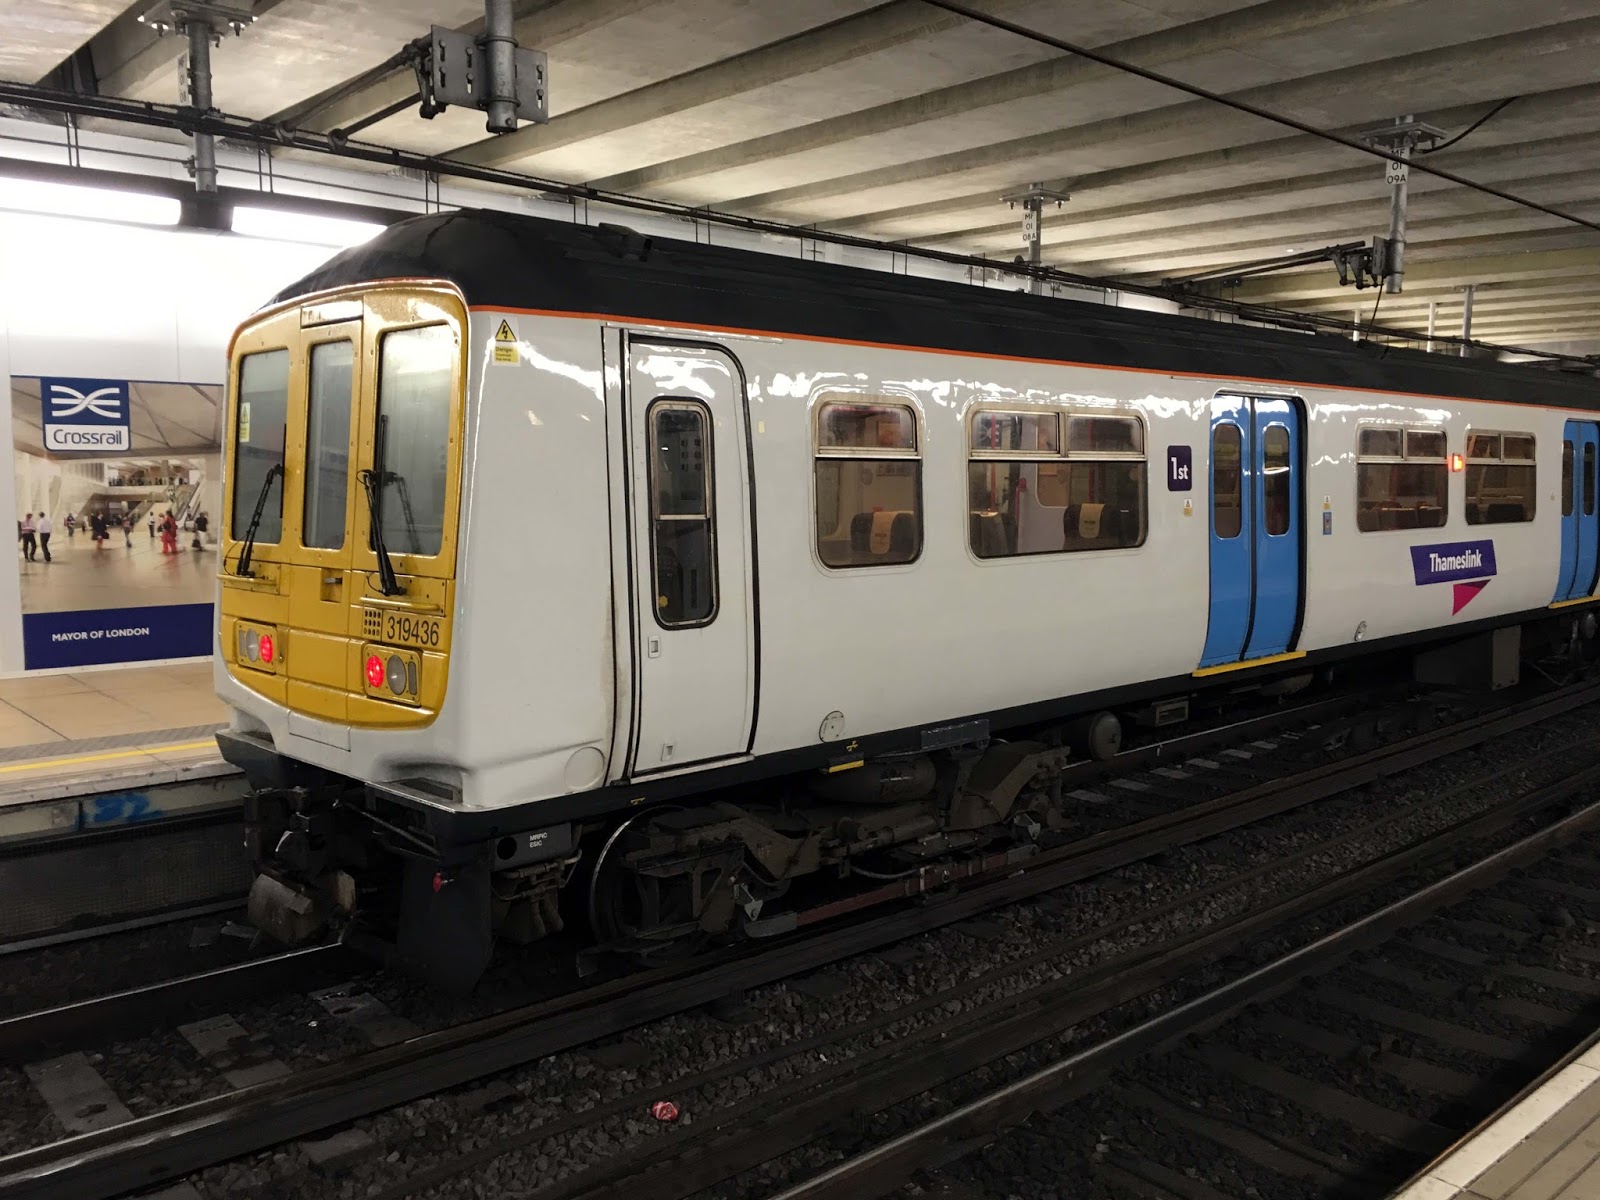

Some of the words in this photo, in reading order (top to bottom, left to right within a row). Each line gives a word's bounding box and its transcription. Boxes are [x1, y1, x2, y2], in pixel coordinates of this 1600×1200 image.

[1387, 174, 1406, 184] 09A
[53, 428, 122, 445] Crossrail
[1170, 456, 1188, 480] 1st
[1429, 548, 1482, 572] Thameslink
[52, 632, 88, 642] MAYOR
[90, 630, 104, 639] OF
[106, 627, 150, 638] LONDON
[387, 616, 439, 646] 319436
